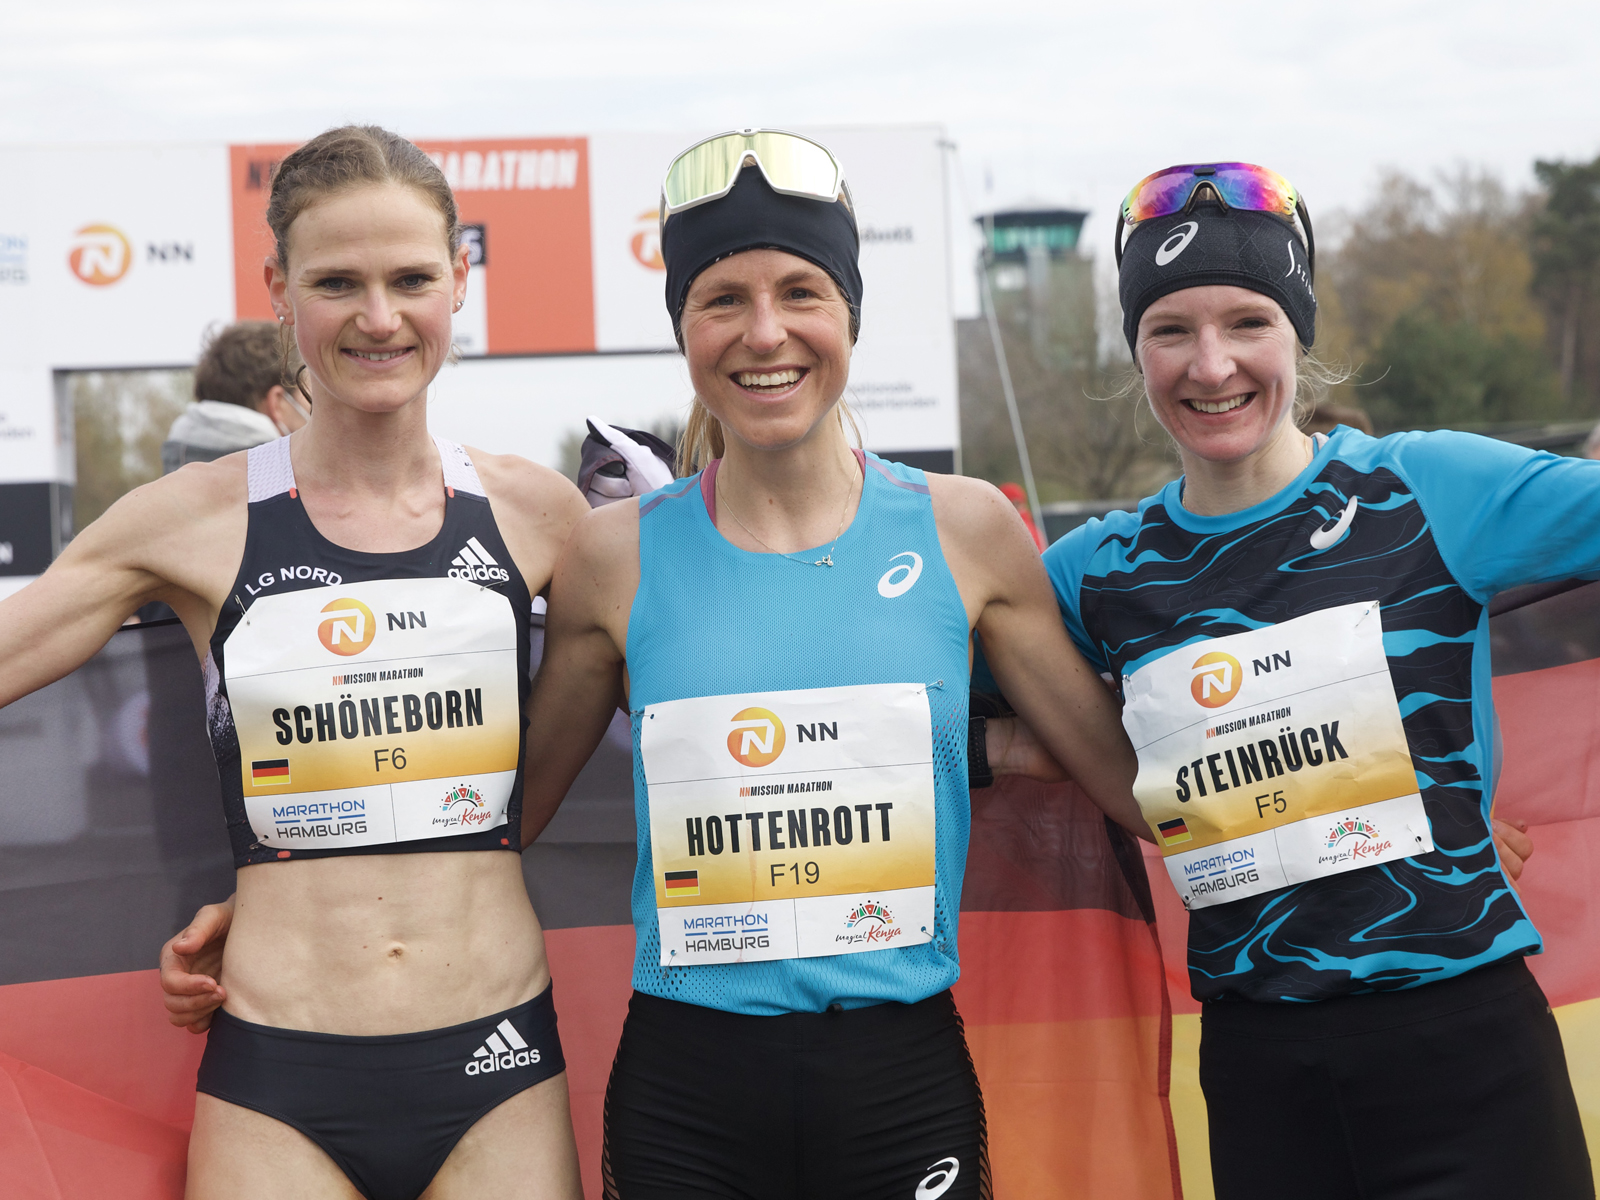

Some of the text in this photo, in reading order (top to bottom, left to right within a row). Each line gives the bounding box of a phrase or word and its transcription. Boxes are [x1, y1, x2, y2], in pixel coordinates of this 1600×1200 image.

[147, 241, 194, 263] NN
[244, 565, 343, 596] LG NORD
[447, 564, 510, 581] adidas
[386, 610, 427, 631] NN
[379, 667, 424, 682] MARATHON
[1252, 650, 1292, 677] NN
[272, 687, 484, 746] SCHÖNEBORN
[1248, 706, 1292, 728] MARATHON
[796, 721, 839, 743] NN
[374, 747, 408, 772] F6
[1175, 720, 1349, 803] STEINRÜCK
[787, 780, 833, 794] MARATHON
[272, 799, 365, 818] MARATHON
[1255, 790, 1288, 819] F5
[432, 807, 492, 828] magical Kenya
[276, 820, 368, 839] HAMBURG
[686, 802, 893, 857] HOTTENROTT
[1183, 847, 1255, 876] MARATHON
[1318, 839, 1393, 865] magical Kenya
[770, 860, 820, 887] F19
[1189, 868, 1260, 897] HAMBURG
[683, 913, 768, 930] MARATHON
[685, 935, 770, 953] HAMBURG
[835, 924, 902, 944] magical Kenya
[465, 1048, 541, 1076] adidas
